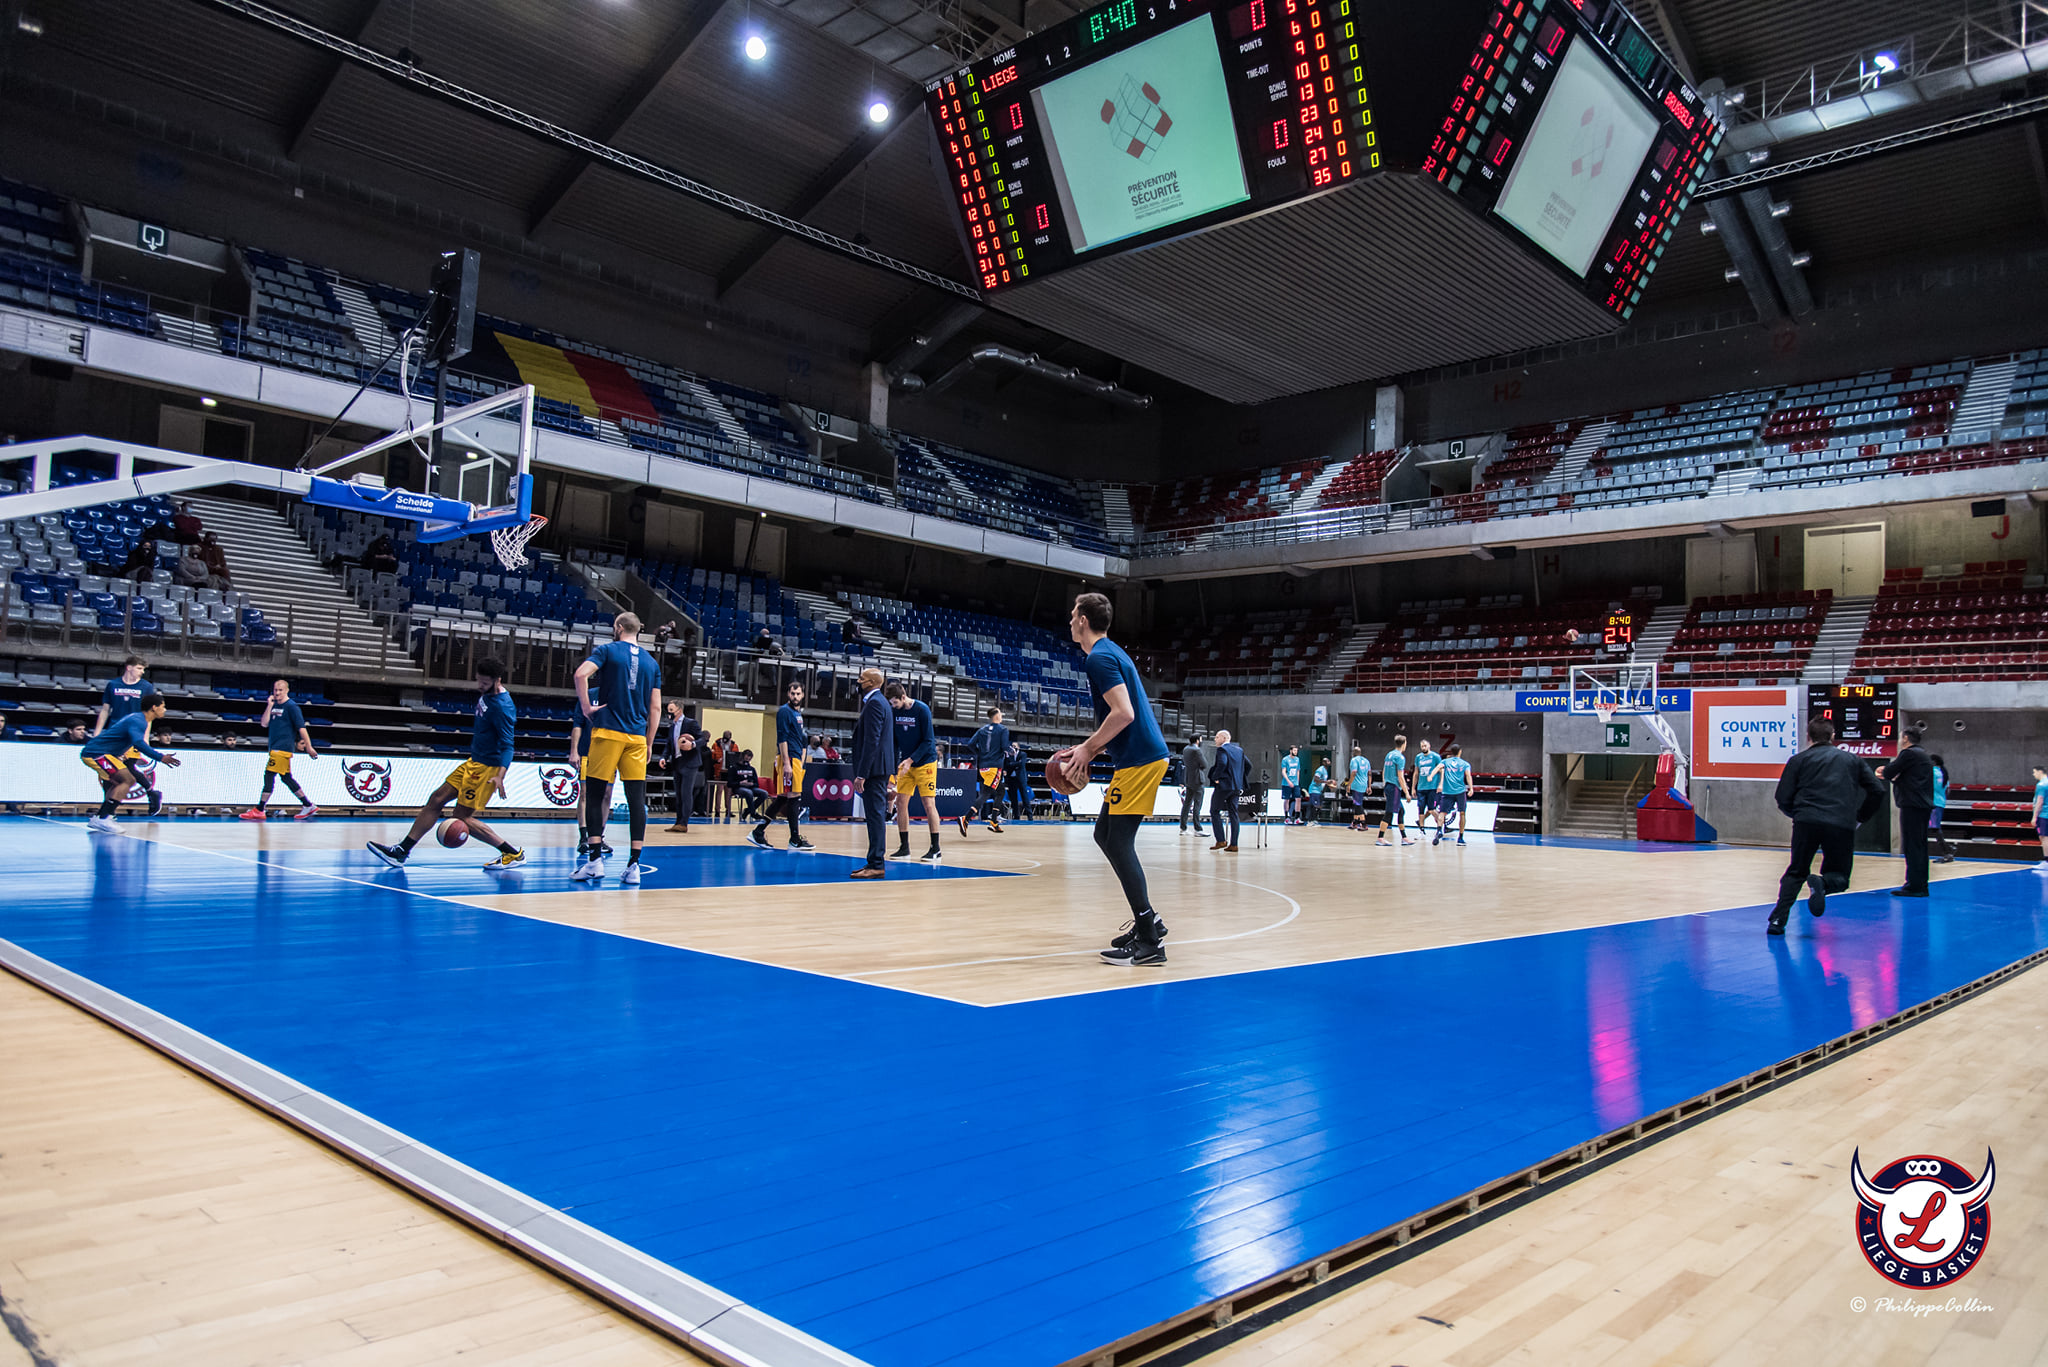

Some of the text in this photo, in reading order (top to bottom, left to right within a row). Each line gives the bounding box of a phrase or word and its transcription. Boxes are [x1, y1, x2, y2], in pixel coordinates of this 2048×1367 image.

[1090, 0, 1137, 43] 8:40
[1148, 7, 1156, 20] 3
[1250, 0, 1267, 32] 0
[1290, 0, 1350, 37] 6 0 0
[1495, 11, 1505, 30] 7
[1239, 37, 1263, 54] POINTS
[1294, 21, 1355, 56] 9 0 0
[1482, 33, 1494, 50] 8
[1547, 26, 1566, 56] 0
[993, 48, 1017, 66] HOME
[1045, 46, 1071, 66] 1 2
[1295, 43, 1359, 81] 10 0 0
[1470, 52, 1485, 71] 11
[981, 65, 1019, 93] LIEGE
[1246, 63, 1270, 79] TIME-OUT
[937, 87, 944, 101] 1
[948, 81, 957, 96] 0
[967, 73, 975, 87] 0
[1268, 80, 1287, 94] BONUS
[1299, 65, 1363, 102] 13 0 0
[1461, 74, 1475, 92] 12
[1270, 89, 1289, 102] SERVICE
[1452, 95, 1465, 113] 13
[1680, 84, 1696, 105] GUEST
[940, 91, 980, 120] 2 0 0
[1300, 87, 1368, 125] 23 0 0
[1663, 90, 1695, 130] BRUSSELS
[944, 109, 985, 136] 4 0 0
[1009, 102, 1023, 131] 0
[1442, 116, 1456, 133] 15
[1273, 118, 1289, 150] 0
[1304, 109, 1372, 146] 24 0 0
[949, 126, 990, 154] 6 0 0
[1308, 130, 1376, 166] 27 0 0
[1431, 134, 1447, 153] 31
[955, 144, 995, 170] 7 0 0
[1267, 155, 1287, 169] FOULS
[1493, 138, 1512, 166] 0
[959, 161, 1000, 188] 8 0 0
[1313, 151, 1380, 187] 35 0 0
[1422, 155, 1437, 174] 32
[962, 179, 1005, 206] 11 0 0
[967, 196, 1010, 222] 12 0 0
[1035, 203, 1050, 230] 0
[972, 213, 1015, 239] 13 0 0
[976, 230, 1020, 255] 15 0 0
[1034, 234, 1050, 246] FOULS
[978, 247, 1024, 273] 31 0 0
[983, 263, 1029, 289] 32 0 0
[1494, 380, 1522, 402] H2
[395, 503, 433, 514] International
[396, 495, 434, 508] Schelde
[1991, 515, 2010, 540] J
[1543, 555, 1560, 574] H
[1609, 615, 1631, 625] 8:40
[1604, 627, 1631, 644] 24
[1525, 696, 1568, 707] COUNTR
[1884, 708, 1894, 720] 0
[1721, 721, 1786, 733] COUNTRY
[1881, 725, 1892, 736] 0
[1722, 737, 1787, 748] HALL
[1837, 742, 1883, 755] Quick
[359, 772, 377, 792] L
[553, 778, 568, 796] L
